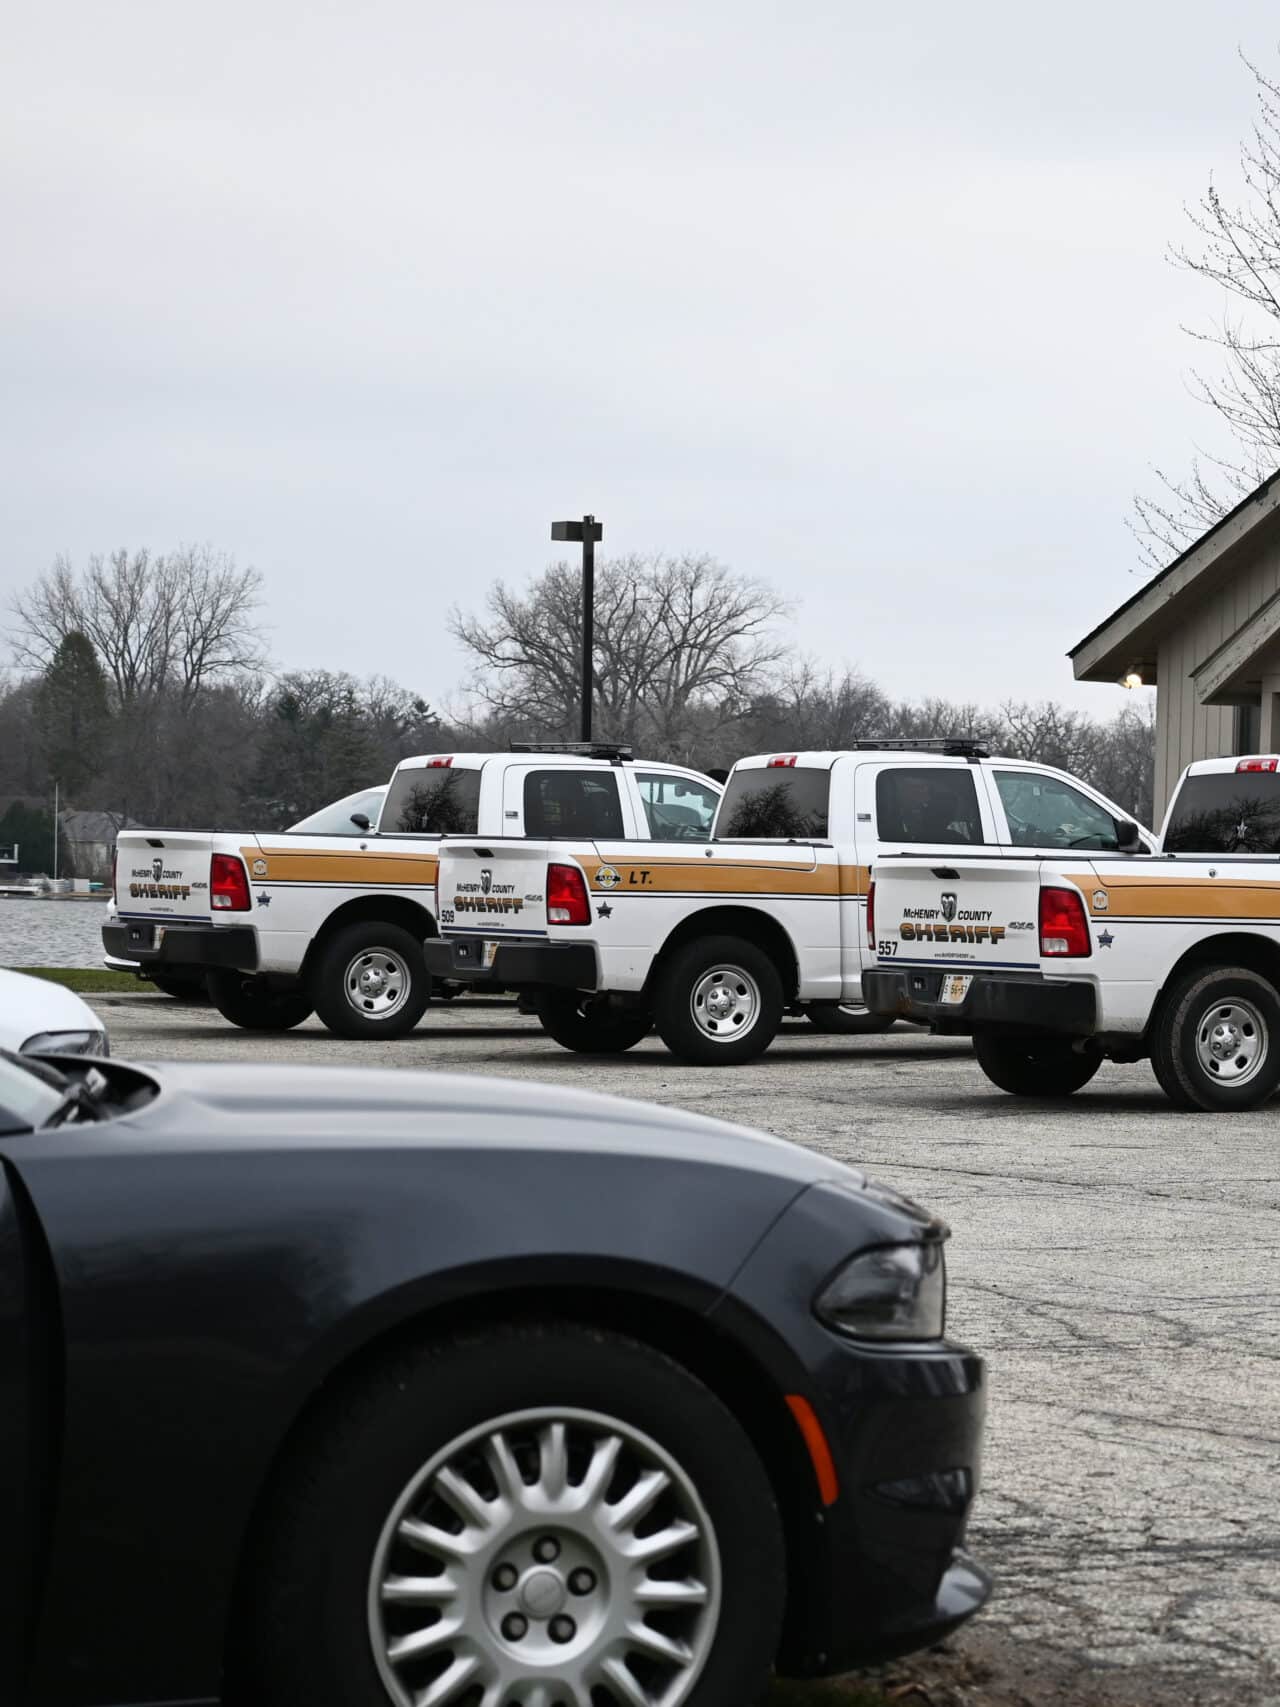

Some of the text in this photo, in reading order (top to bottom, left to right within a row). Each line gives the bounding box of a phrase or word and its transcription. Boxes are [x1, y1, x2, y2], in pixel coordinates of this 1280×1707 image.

[162, 870, 183, 880] COUNTY
[629, 871, 653, 885] LT.
[129, 883, 191, 901] SHERIFF
[491, 884, 516, 894] COUNTY
[453, 895, 524, 914] SHERIFF
[441, 909, 455, 923] 509
[903, 908, 993, 921] McHENRY COUNTY
[899, 922, 1006, 945] SHERIFF
[878, 940, 898, 956] 557
